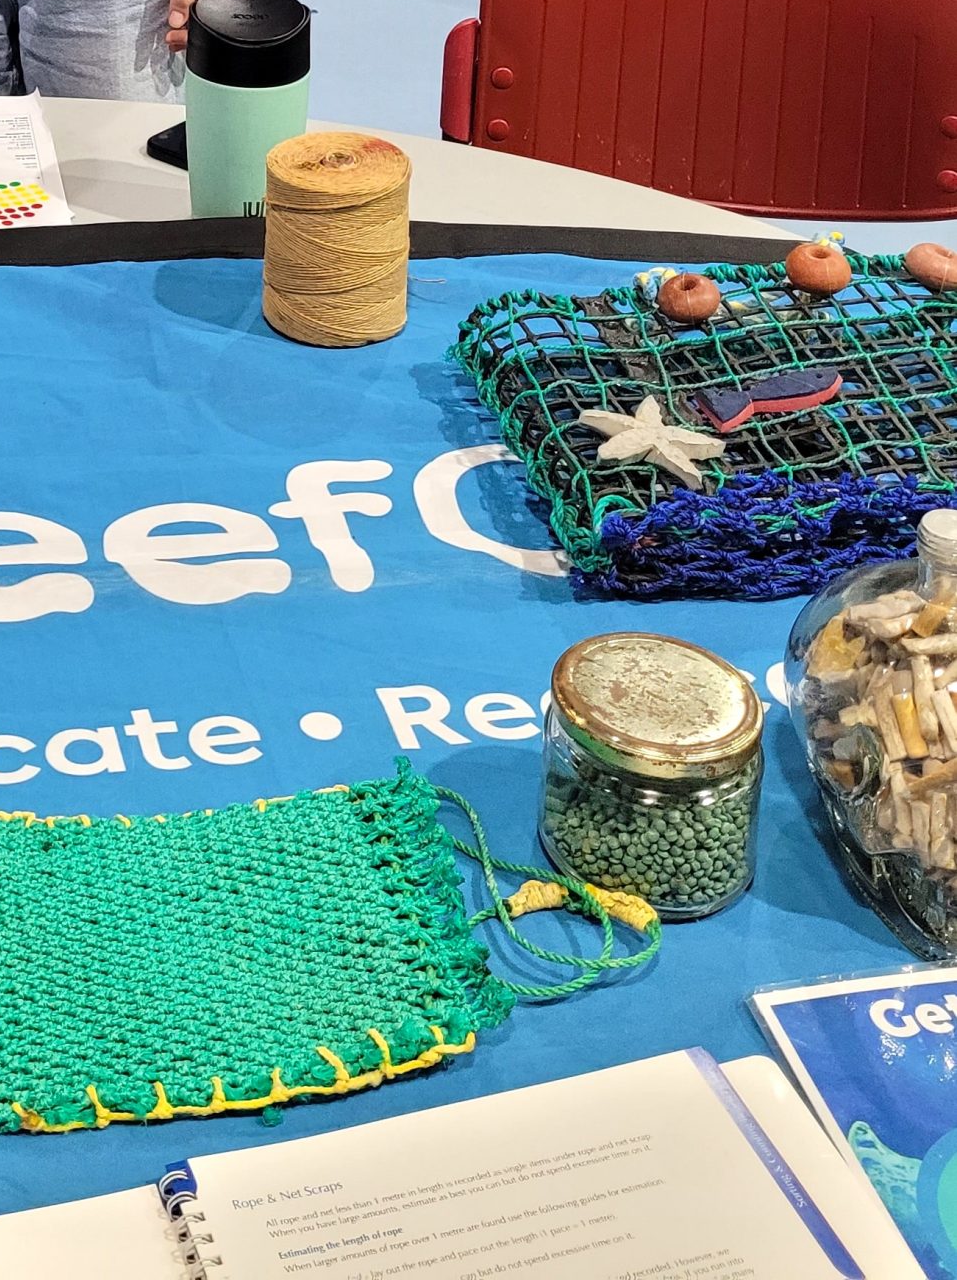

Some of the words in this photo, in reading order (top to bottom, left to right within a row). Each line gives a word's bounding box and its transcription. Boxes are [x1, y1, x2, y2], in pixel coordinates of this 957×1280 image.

[376, 684, 552, 750] Re
[232, 1197, 267, 1210] Rope
[268, 1194, 277, 1204] &
[280, 1189, 302, 1201] Net
[304, 1181, 343, 1195] Scraps
[266, 1220, 279, 1228] All
[280, 1215, 300, 1226] rope
[302, 1211, 318, 1220] and
[320, 1208, 334, 1216] net
[335, 1204, 351, 1213] less
[353, 1200, 373, 1209] than
[382, 1192, 406, 1203] metre
[408, 1189, 417, 1197] in
[417, 1182, 444, 1194] length
[454, 1170, 491, 1185] recorded
[503, 1162, 527, 1173] single
[529, 1158, 551, 1168] items
[552, 1151, 575, 1162] under
[578, 1146, 596, 1156] rope
[599, 1141, 614, 1151] and
[615, 1138, 628, 1147] net
[269, 1227, 296, 1239] When
[298, 1224, 314, 1235] you
[316, 1219, 337, 1229] have
[339, 1214, 360, 1225] large
[362, 1205, 400, 1219] amounts,
[402, 1197, 436, 1210] estimate
[448, 1189, 466, 1199] best
[467, 1185, 484, 1196] you
[486, 1181, 501, 1190] can
[502, 1176, 517, 1186] but
[518, 1173, 530, 1182] do
[531, 1169, 545, 1179] not
[546, 1163, 572, 1176] spend
[572, 1155, 610, 1169] excessive
[611, 1149, 630, 1160] time
[631, 1146, 642, 1155] on
[278, 1243, 327, 1260] Estimating
[326, 1240, 340, 1250] the
[341, 1234, 370, 1246] length
[372, 1229, 382, 1239] of
[383, 1226, 404, 1238] rope
[284, 1261, 312, 1273] When
[313, 1257, 338, 1268] larger
[341, 1248, 377, 1262] amounts
[379, 1243, 388, 1252] of
[389, 1239, 410, 1251] rope
[412, 1235, 430, 1246] over
[432, 1232, 438, 1240] 1
[440, 1227, 465, 1238] metre
[466, 1223, 480, 1232] are
[481, 1216, 506, 1228] found
[507, 1213, 522, 1222] use
[524, 1209, 537, 1218] the
[538, 1200, 579, 1214] following
[579, 1193, 607, 1206] guides
[608, 1188, 619, 1197] for
[386, 1264, 401, 1274] out
[402, 1261, 416, 1271] the
[417, 1257, 438, 1268] rope
[440, 1252, 457, 1262] and
[458, 1247, 479, 1260] pace
[480, 1243, 494, 1252] out
[495, 1239, 510, 1248] the
[511, 1232, 539, 1245] length
[550, 1225, 570, 1237] pace
[477, 1267, 493, 1277] but
[494, 1263, 506, 1272] do
[508, 1260, 522, 1270] not
[524, 1253, 549, 1267] spend
[551, 1243, 590, 1258] excessive
[592, 1239, 610, 1249] time
[612, 1235, 624, 1243] on
